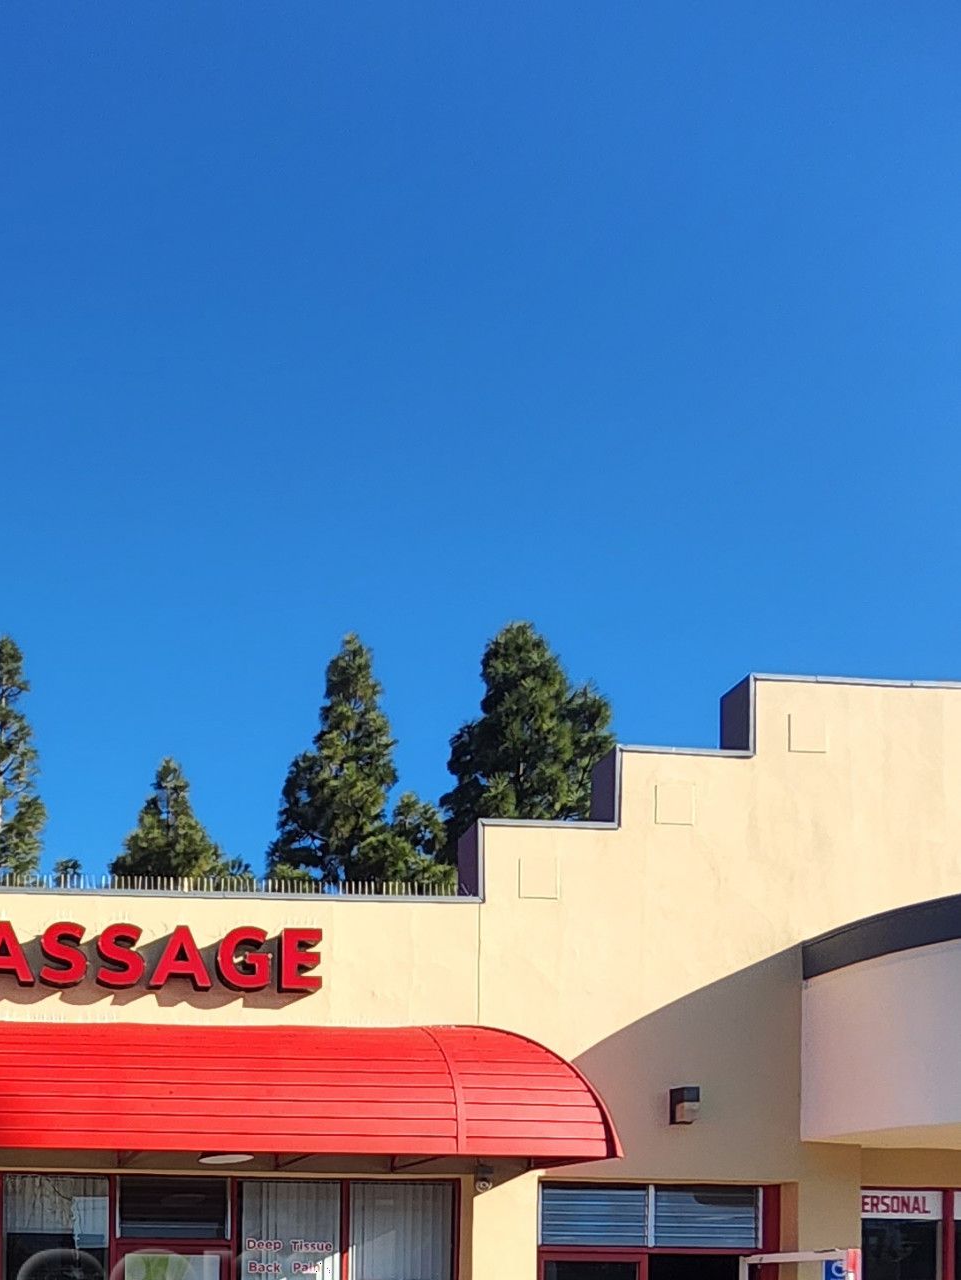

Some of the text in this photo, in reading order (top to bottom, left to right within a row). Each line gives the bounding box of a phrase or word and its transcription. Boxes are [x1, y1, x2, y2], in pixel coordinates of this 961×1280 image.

[247, 1239, 332, 1252] Deep Tissue
[249, 1261, 322, 1273] Back Pain
